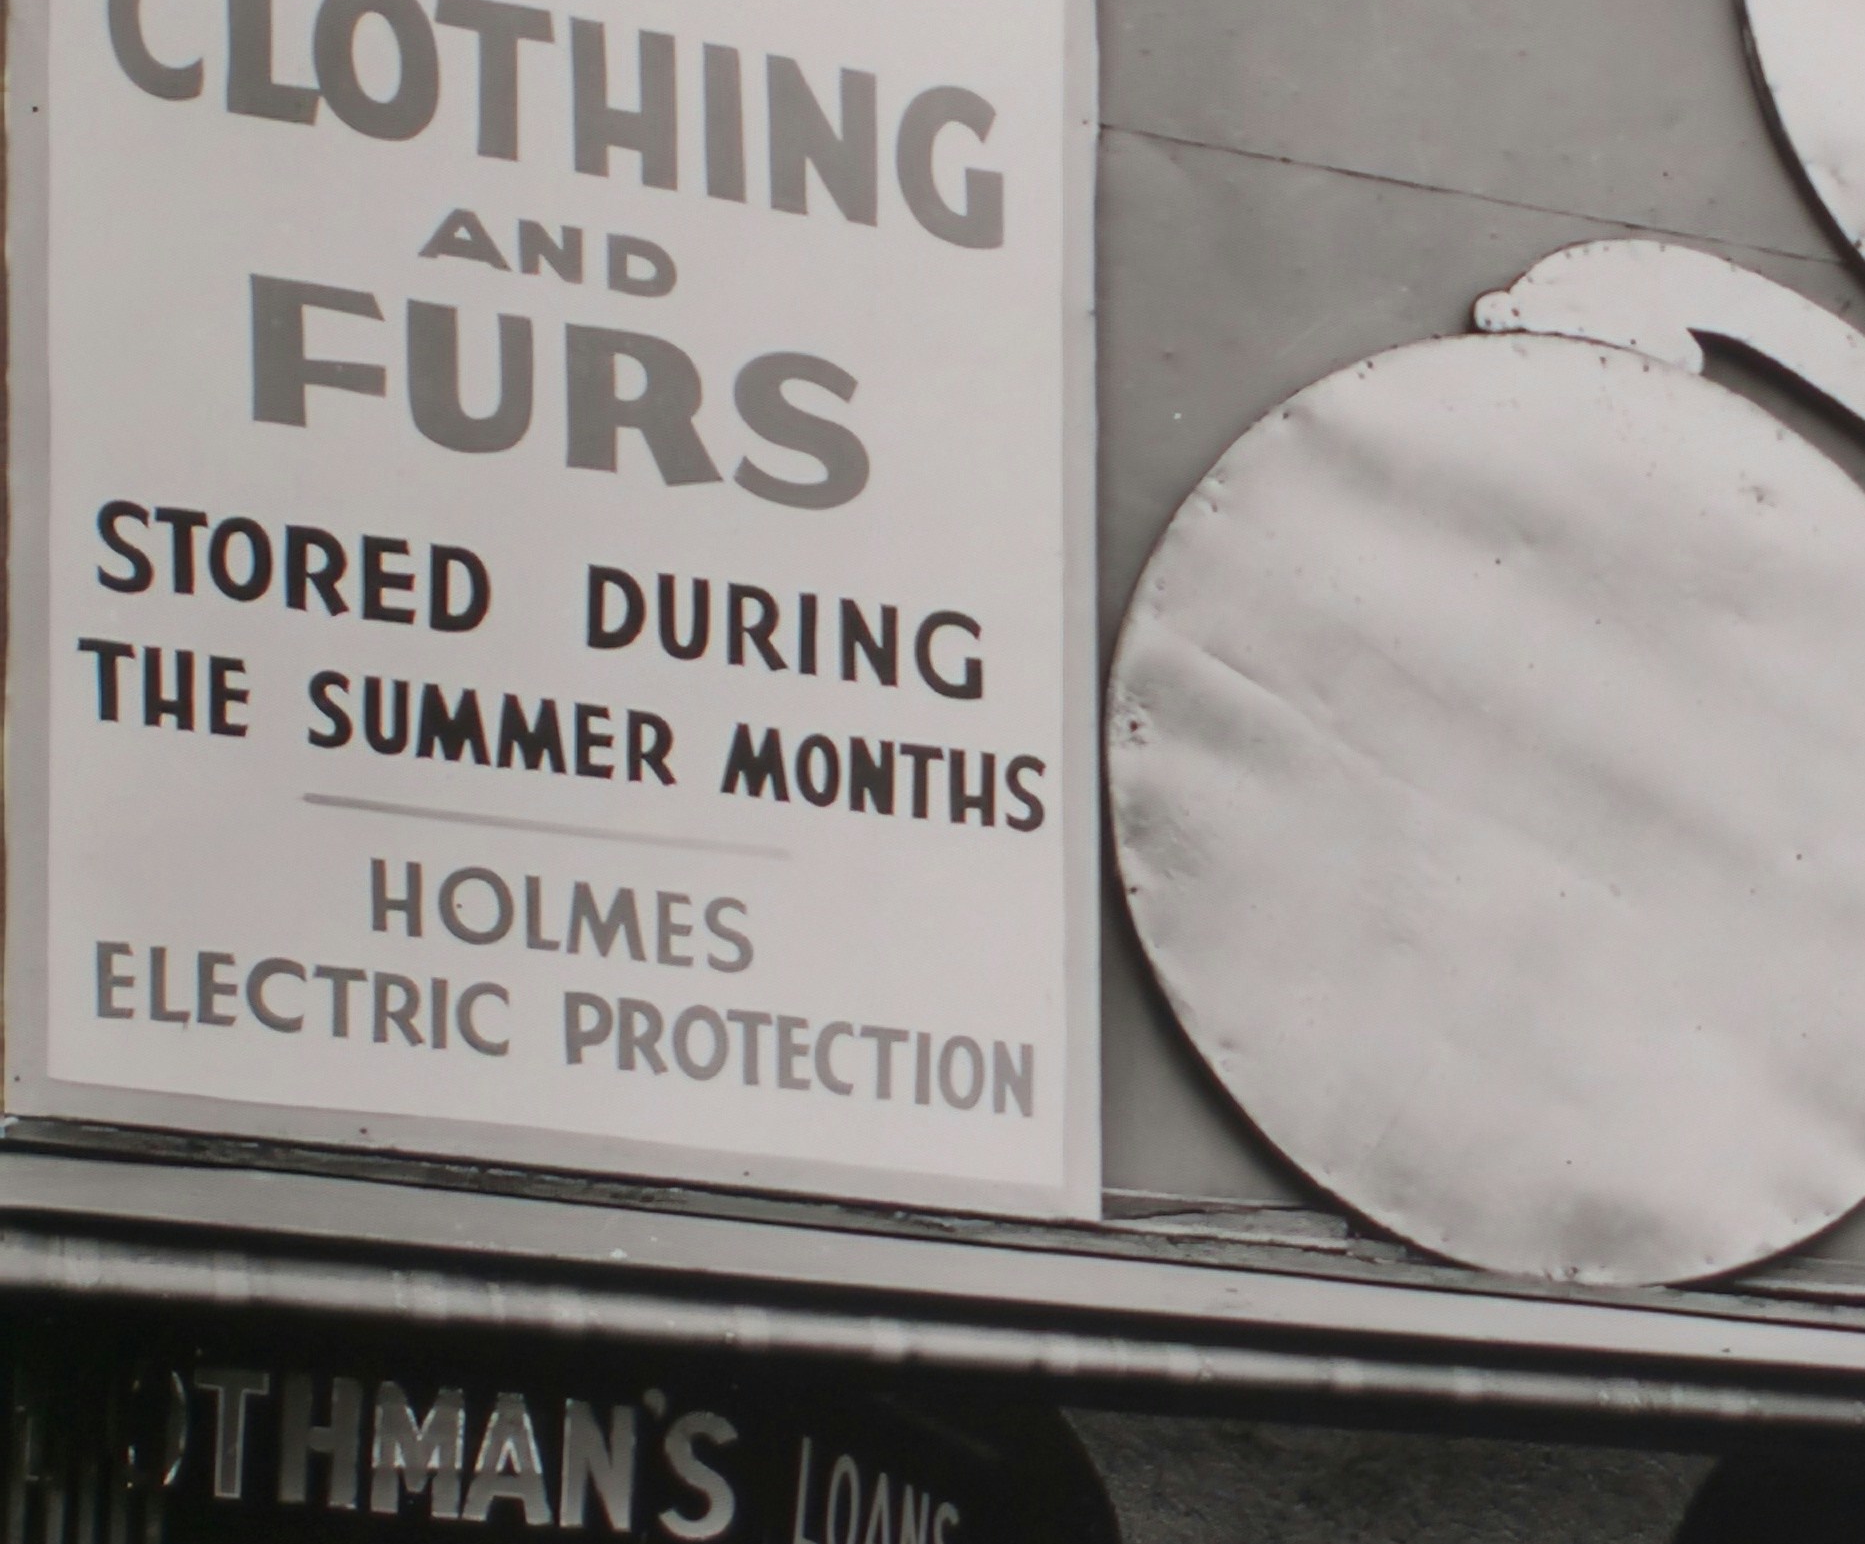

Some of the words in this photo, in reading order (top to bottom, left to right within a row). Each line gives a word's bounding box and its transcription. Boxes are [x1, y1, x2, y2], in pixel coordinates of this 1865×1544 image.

[419, 209, 676, 297] AND
[250, 274, 869, 509] FURS
[98, 501, 490, 632] STORED
[587, 565, 982, 700] DURING
[78, 639, 248, 737] THE
[309, 671, 675, 785] SUMMER
[721, 724, 1045, 832] MONTHS
[371, 858, 752, 972] HOLMES
[96, 942, 508, 1056] ELECTRIC
[564, 991, 1033, 1117] PROTECTION
